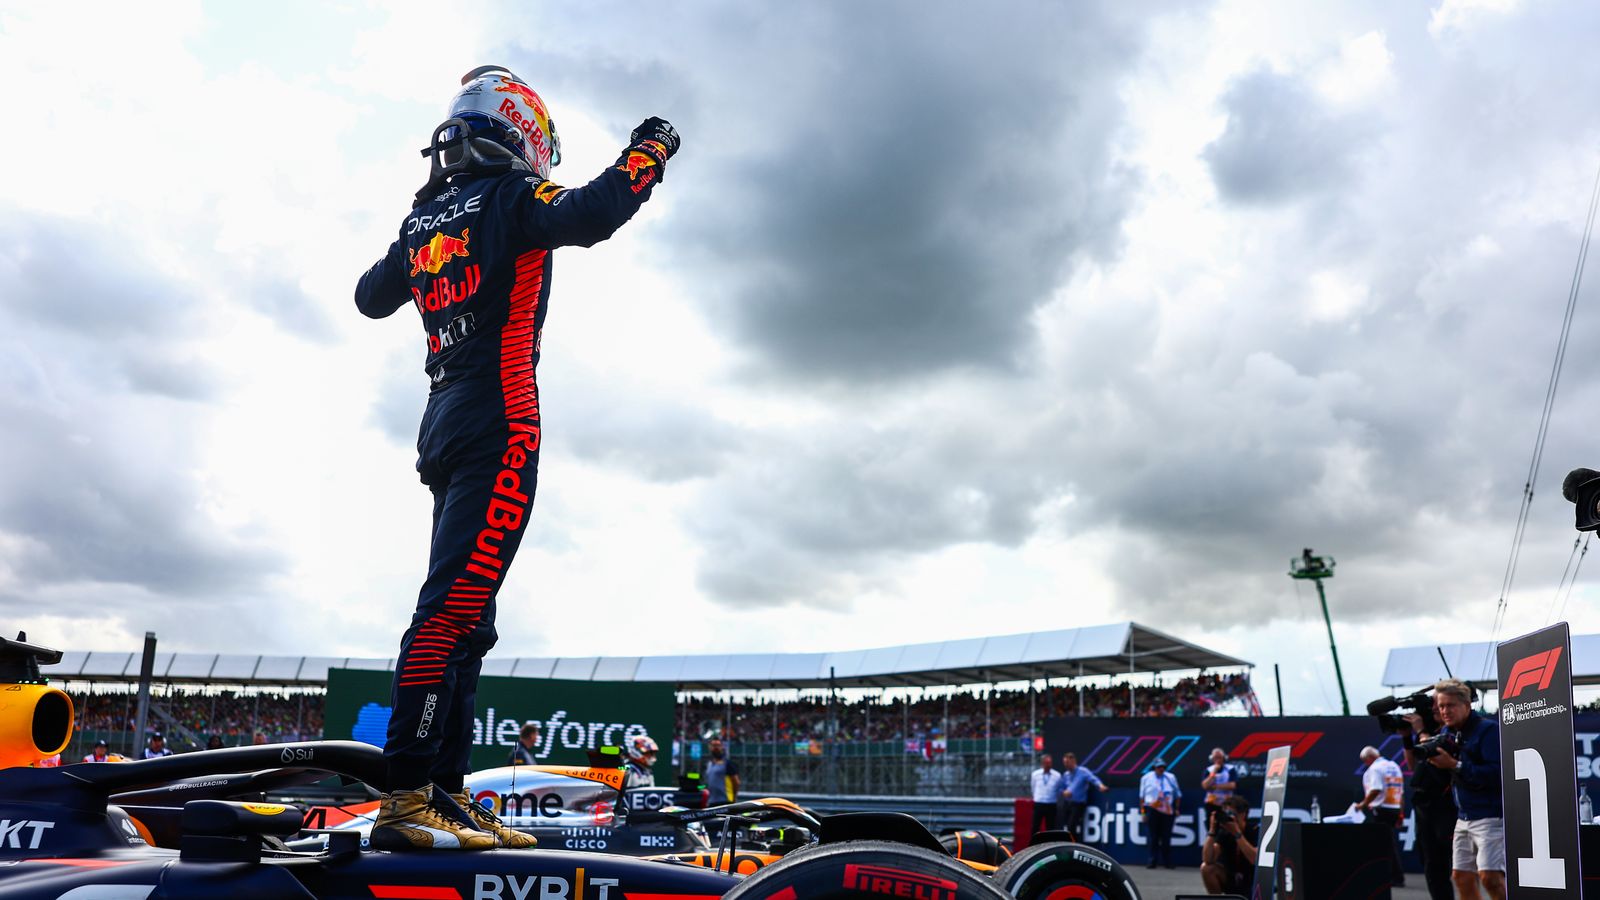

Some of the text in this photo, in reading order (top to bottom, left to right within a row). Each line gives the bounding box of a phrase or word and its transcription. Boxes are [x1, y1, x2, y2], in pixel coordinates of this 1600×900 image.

[407, 194, 482, 235] ORACLE
[465, 422, 541, 581] RedBull
[417, 693, 438, 738] sparco
[296, 748, 314, 761] Sui
[1258, 800, 1280, 867] 2
[1514, 747, 1566, 889] 1
[565, 839, 607, 849] CISCO
[1073, 850, 1113, 872] PIRELLI
[843, 863, 958, 900] PIRELLI
